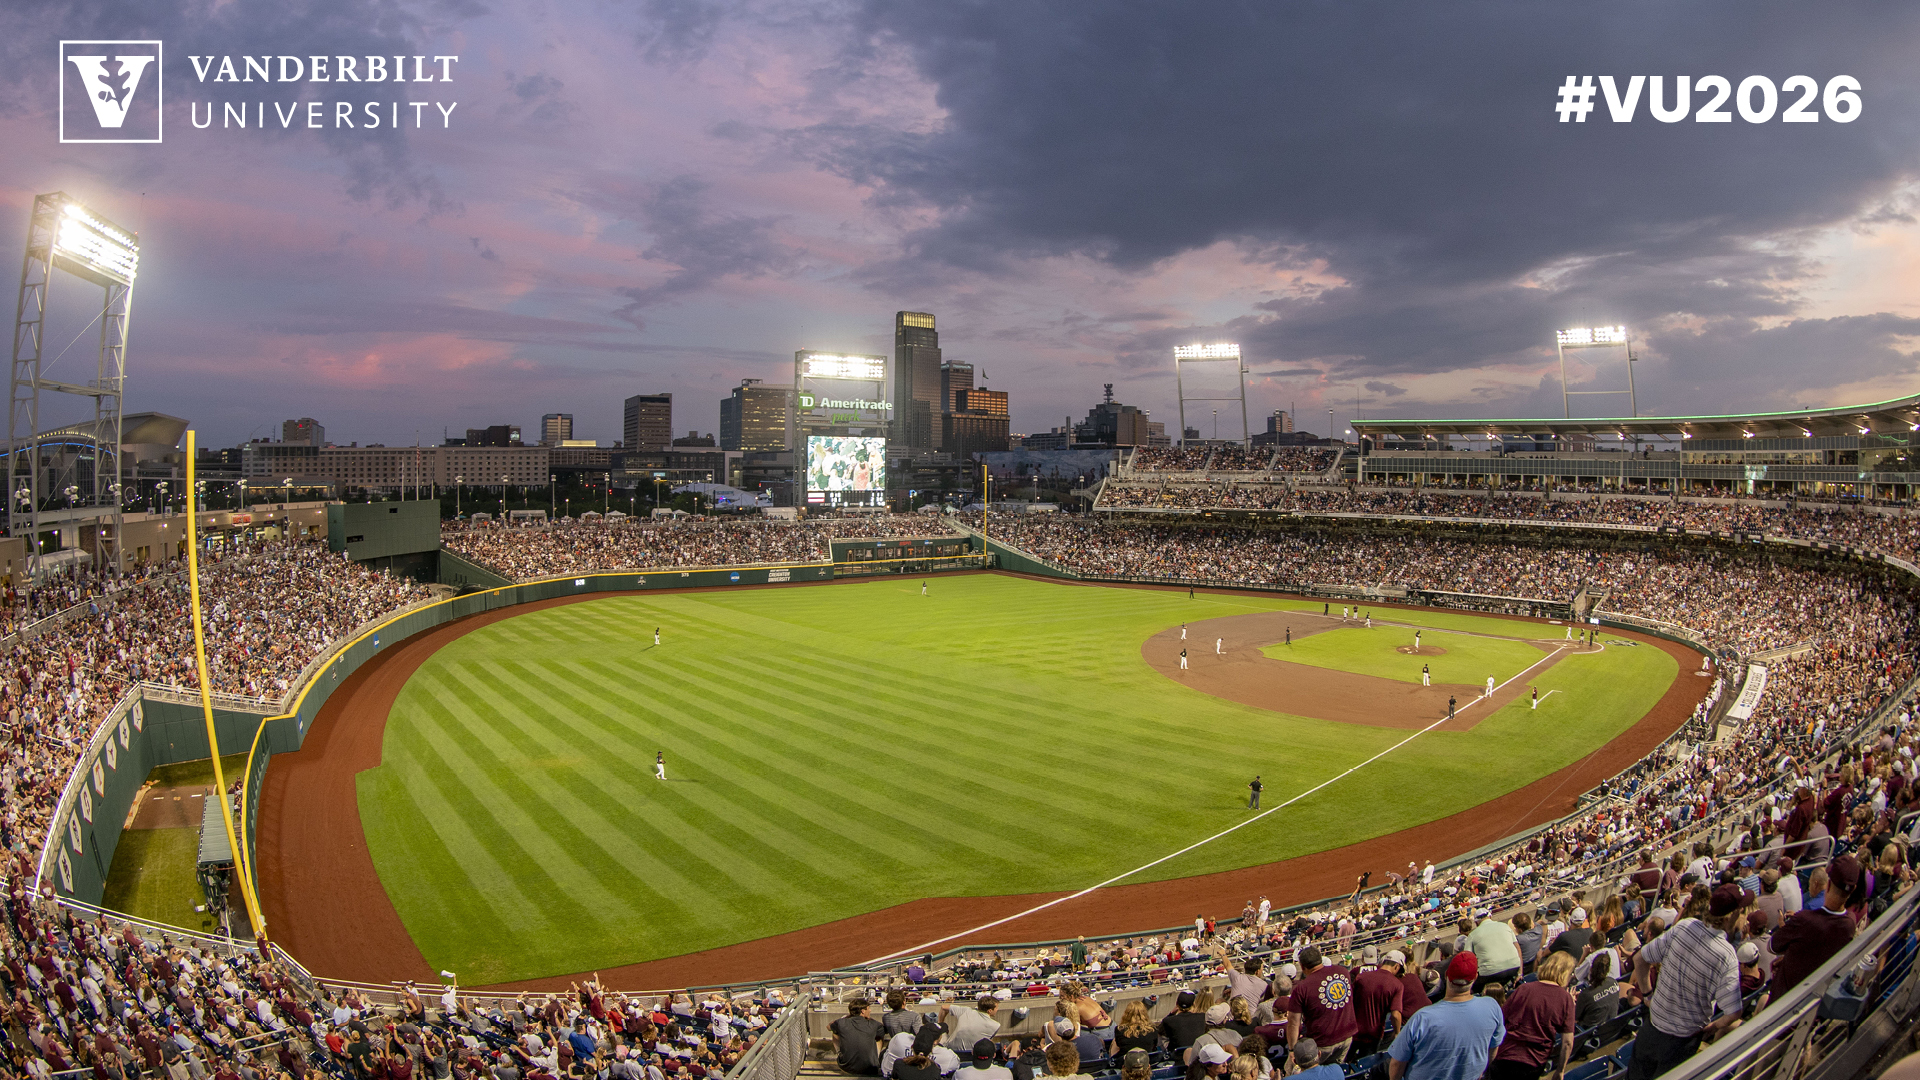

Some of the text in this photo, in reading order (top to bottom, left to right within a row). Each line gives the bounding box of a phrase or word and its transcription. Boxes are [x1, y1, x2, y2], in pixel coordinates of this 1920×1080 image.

[799, 395, 893, 410] TD Ameritrade
[831, 409, 861, 426] park
[1329, 982, 1346, 1000] SEC
